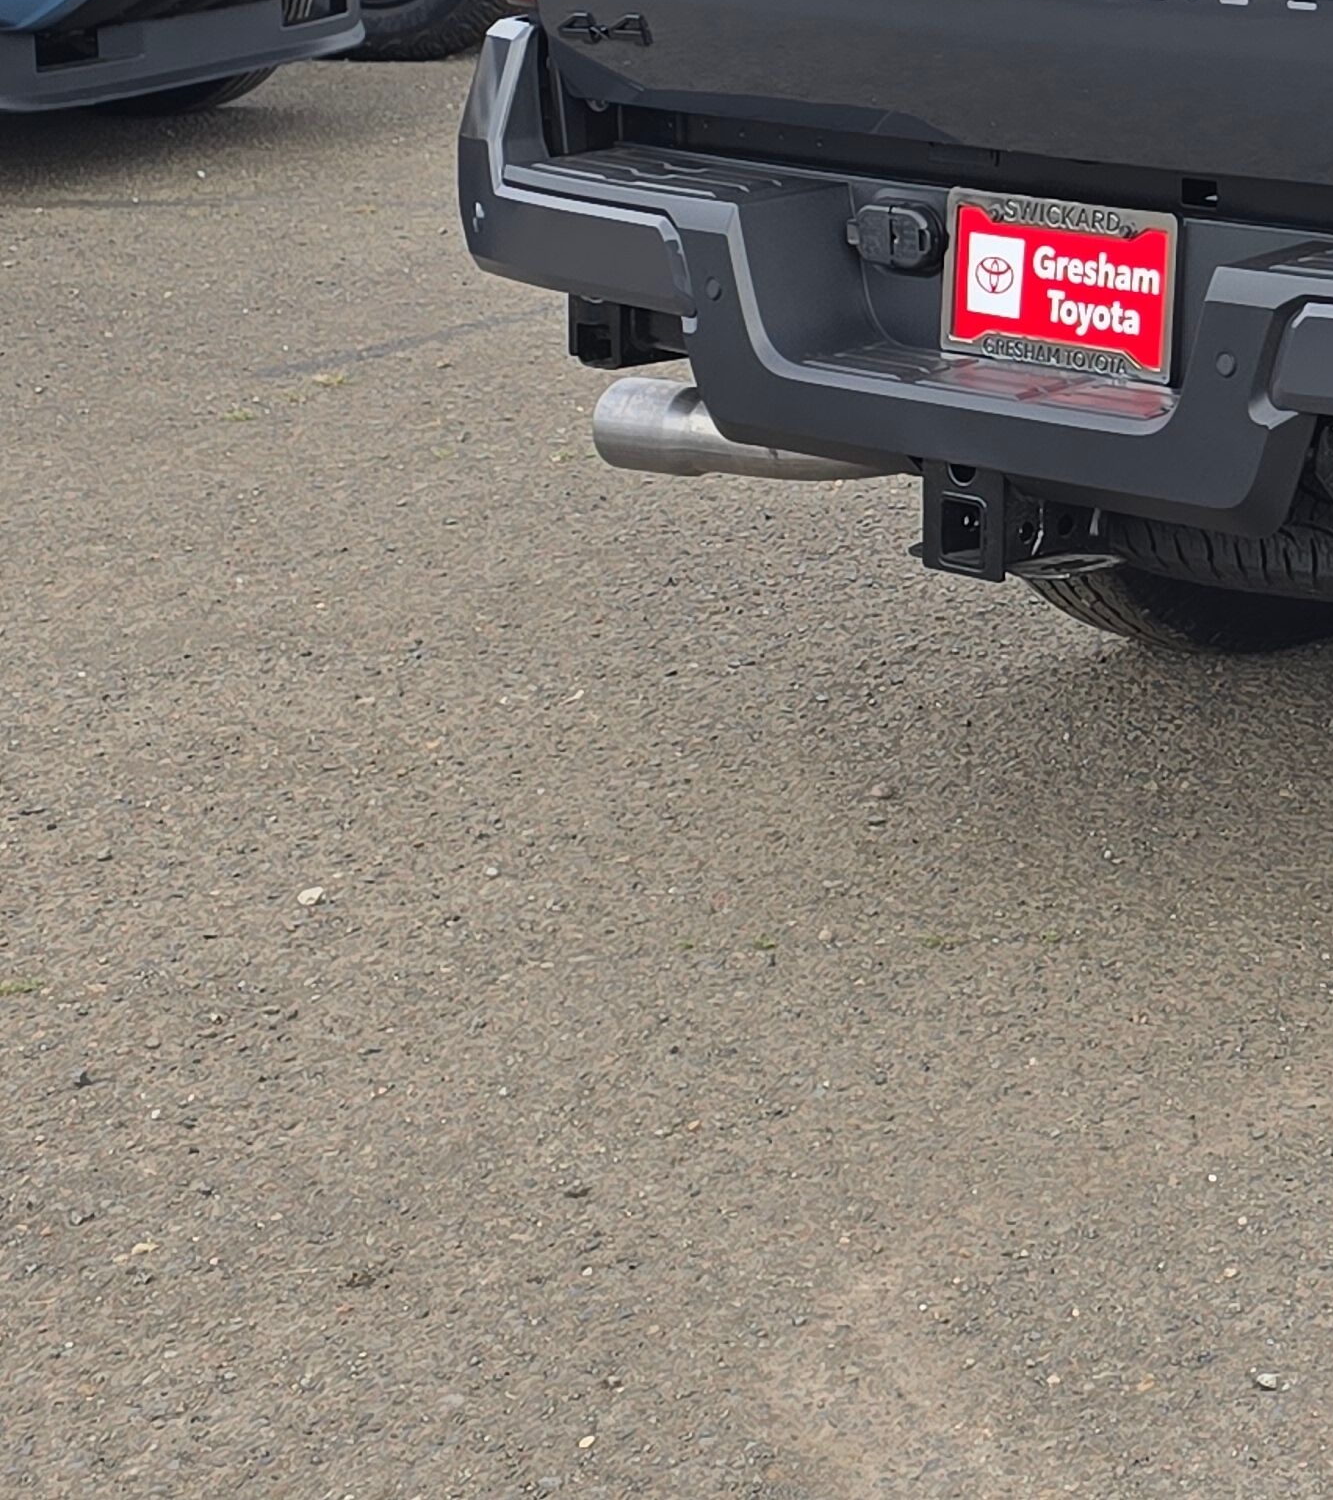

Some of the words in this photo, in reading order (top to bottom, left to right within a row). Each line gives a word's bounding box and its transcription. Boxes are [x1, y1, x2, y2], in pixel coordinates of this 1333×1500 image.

[1002, 199, 1122, 233] SWICKARD
[1033, 245, 1160, 295] Gresham
[1047, 289, 1141, 337] Toyota
[982, 336, 1062, 365] GRESHAM
[1064, 348, 1128, 375] TOYOTA
